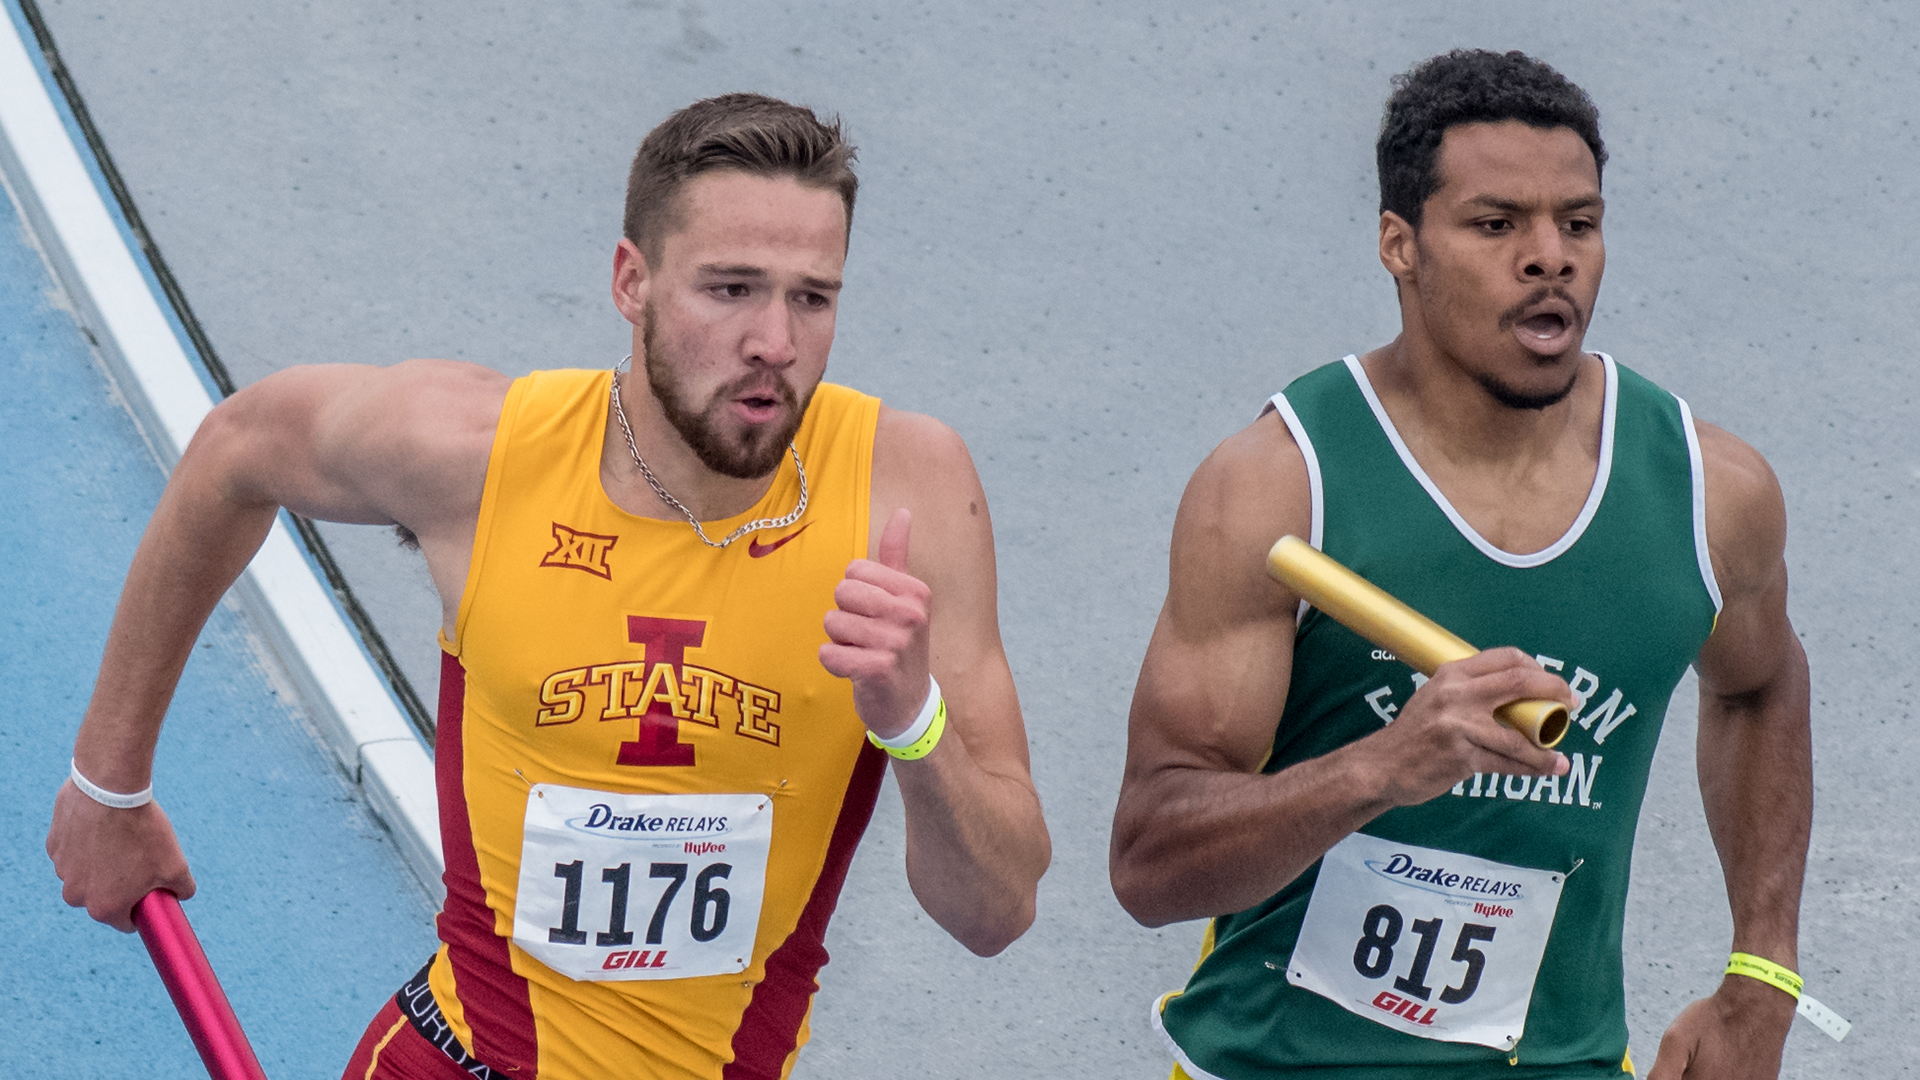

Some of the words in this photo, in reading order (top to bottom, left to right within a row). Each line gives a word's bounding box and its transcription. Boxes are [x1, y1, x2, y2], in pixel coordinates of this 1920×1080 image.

[535, 660, 781, 747] STATE
[584, 803, 663, 832] Drake
[665, 816, 729, 832] RELAYS
[548, 860, 733, 946] 1176
[1383, 853, 1460, 888] Drake
[1460, 876, 1522, 898] RELAYS
[602, 950, 667, 970] GILL
[1353, 904, 1497, 1004] 815
[405, 981, 491, 1080] JORDA
[1372, 991, 1438, 1025] GILL
